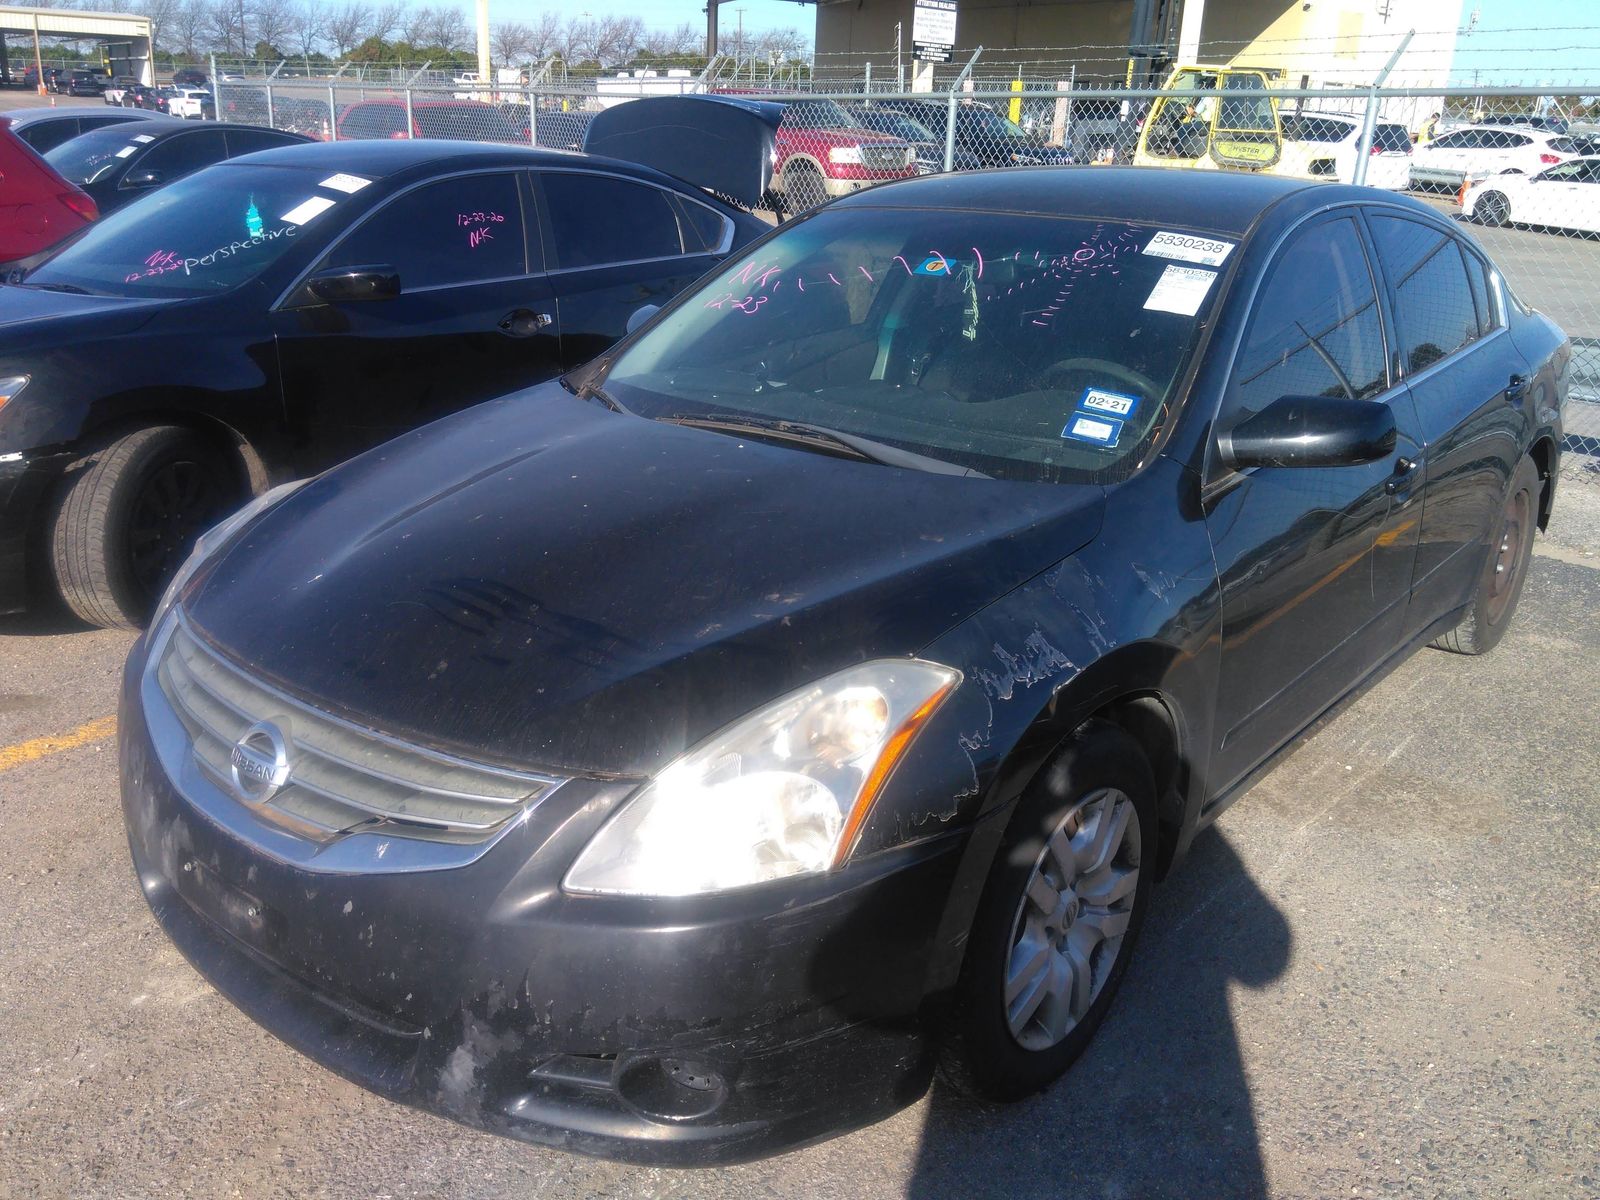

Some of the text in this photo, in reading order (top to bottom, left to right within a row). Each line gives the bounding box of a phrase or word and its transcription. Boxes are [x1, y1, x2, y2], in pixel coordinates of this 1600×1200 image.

[458, 211, 504, 226] 12-23-20
[184, 224, 297, 276] perspective
[1153, 234, 1224, 253] 5830238
[1165, 266, 1216, 279] 5830238
